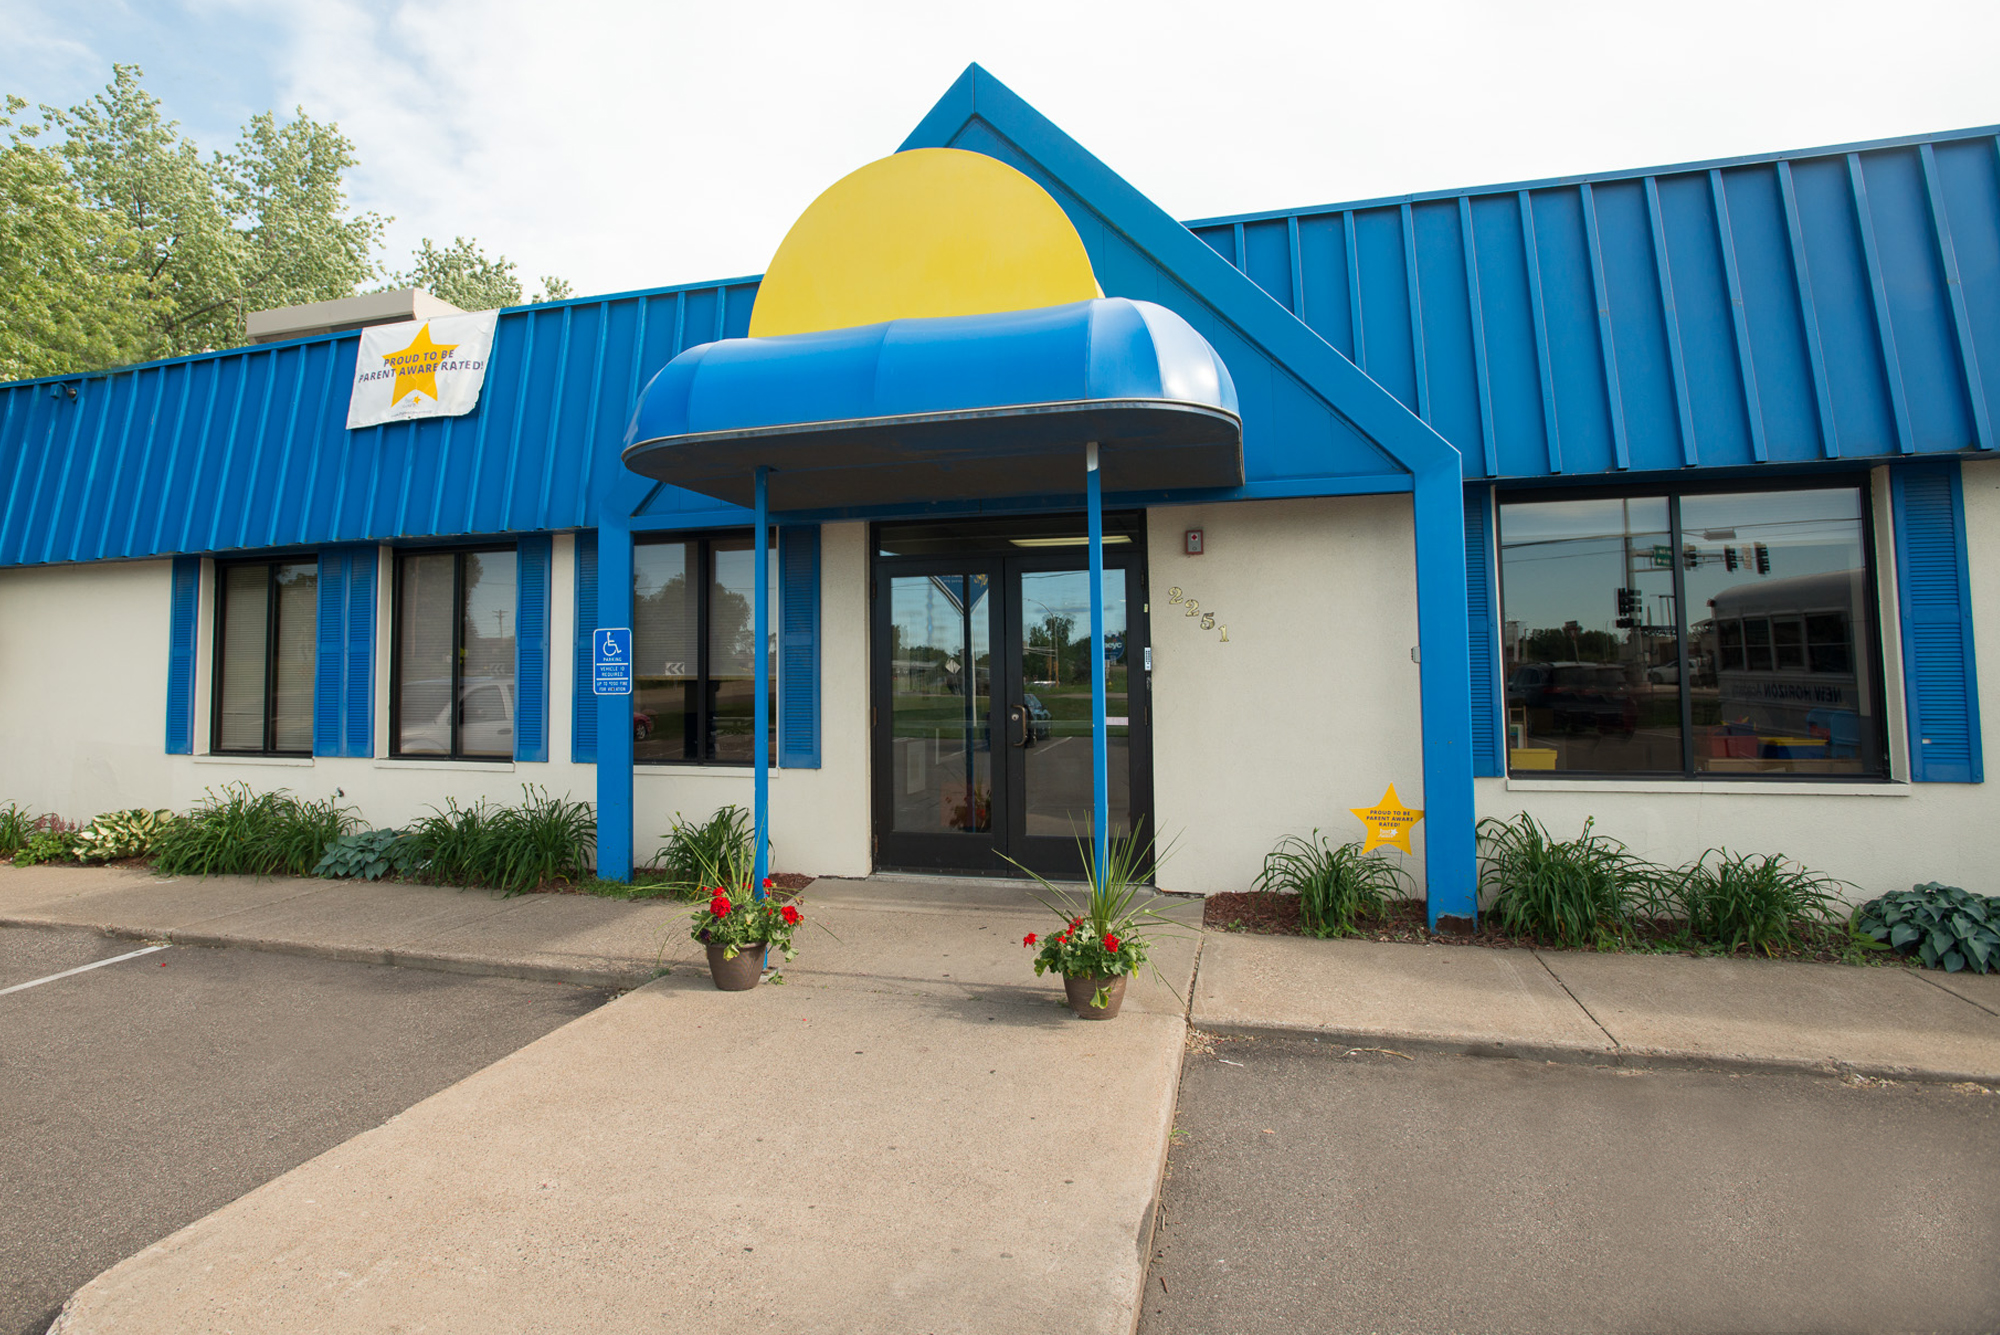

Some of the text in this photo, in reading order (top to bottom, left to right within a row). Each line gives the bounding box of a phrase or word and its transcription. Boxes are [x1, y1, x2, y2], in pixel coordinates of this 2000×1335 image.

[383, 349, 454, 367] PROUD TO BE
[358, 360, 484, 383] PARENT AWARE RATED!
[1168, 586, 1230, 643] 2251
